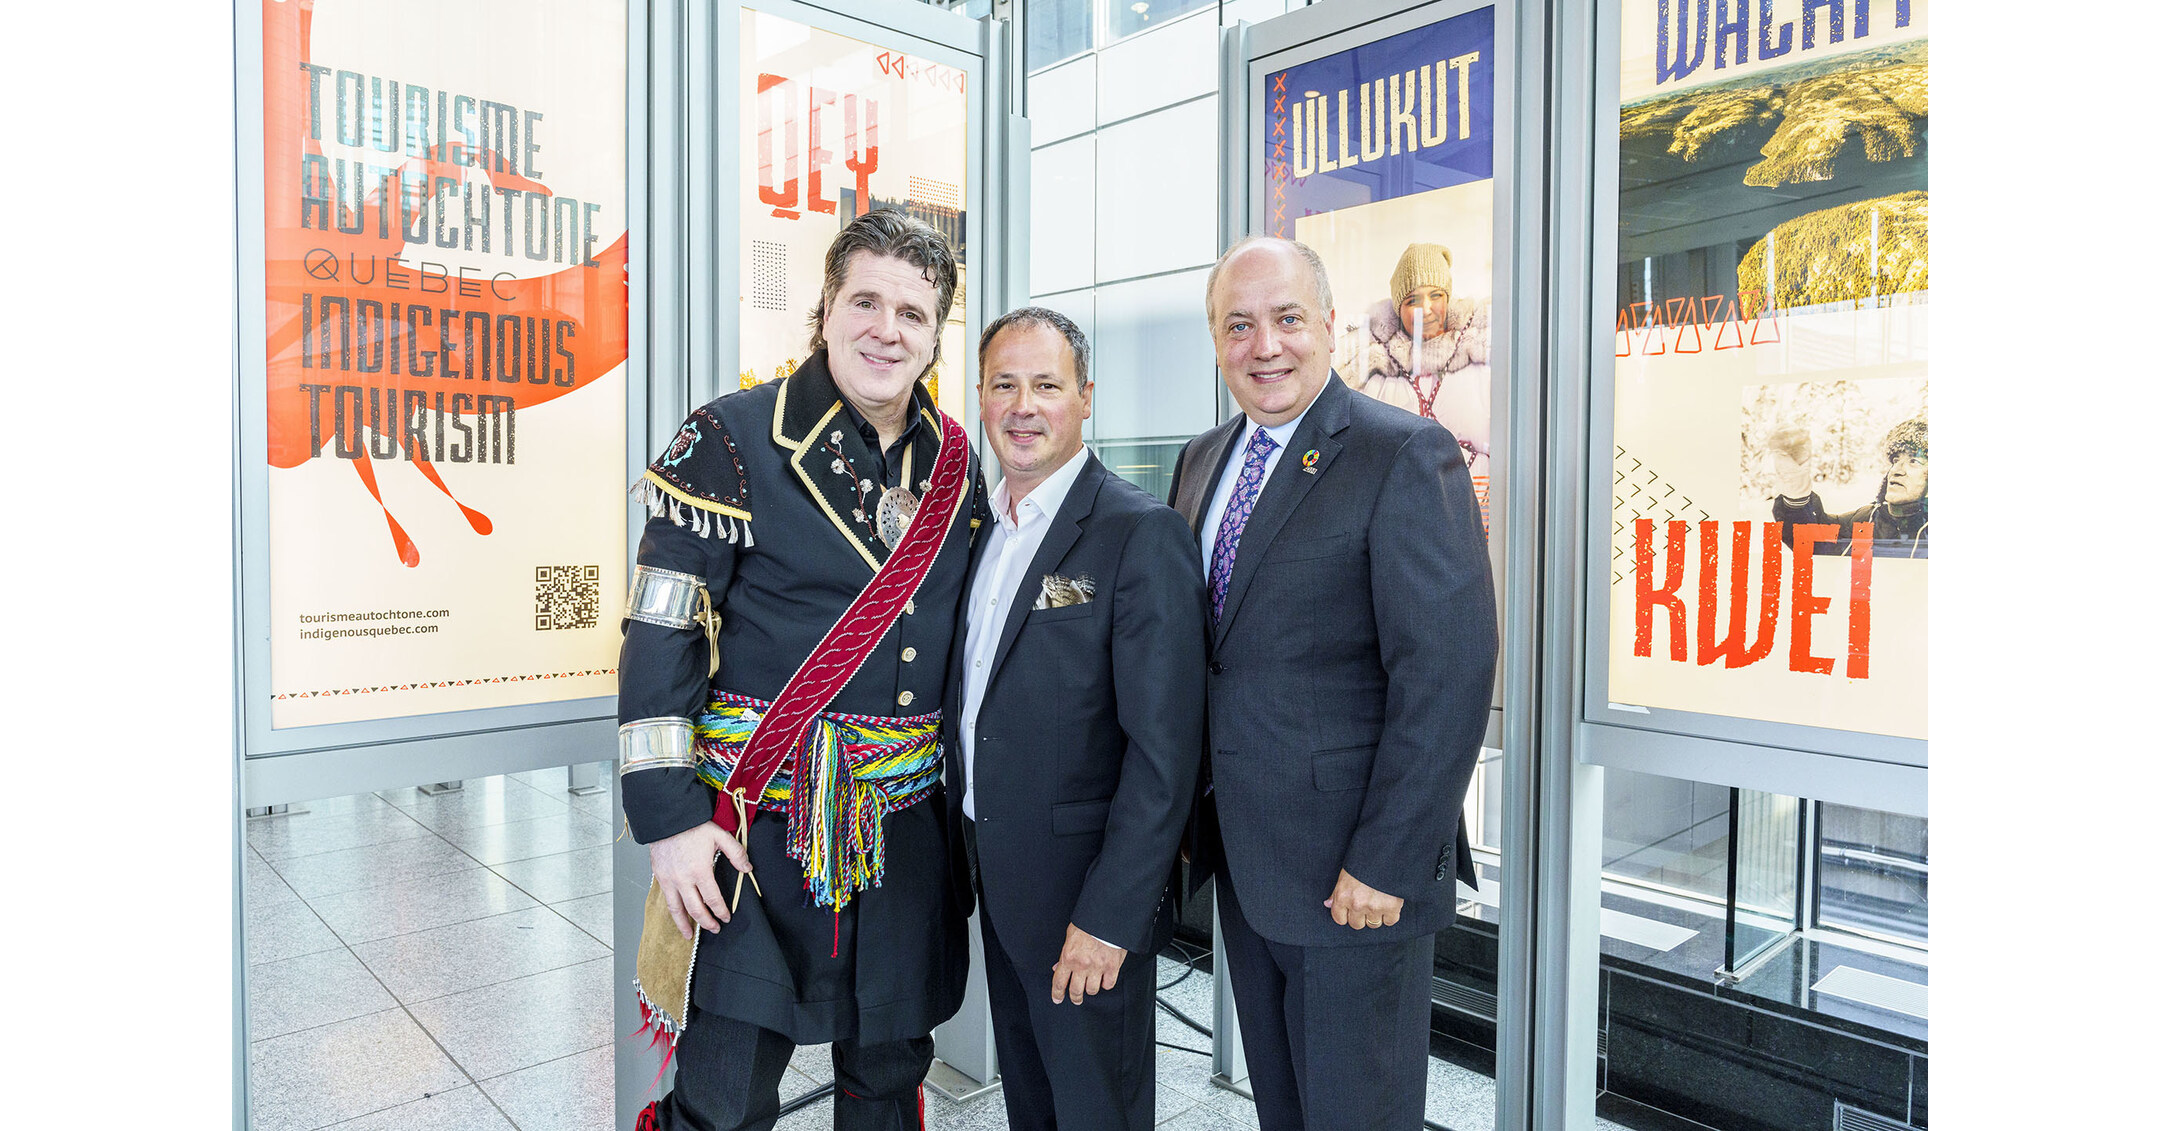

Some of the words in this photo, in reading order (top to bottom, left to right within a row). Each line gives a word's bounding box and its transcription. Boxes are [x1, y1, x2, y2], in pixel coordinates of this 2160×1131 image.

[299, 62, 543, 180] TOURISME
[757, 72, 878, 220] QEY
[301, 153, 601, 268] AUTOCHTONE
[303, 247, 517, 301] QUÉBEC
[301, 293, 576, 387] INDIGENOUS
[299, 383, 516, 465] TOURISM
[299, 608, 450, 624] tourismeautochtone.com
[299, 623, 439, 641] indigenousquebec.com
[1634, 518, 1874, 679] KWEI
